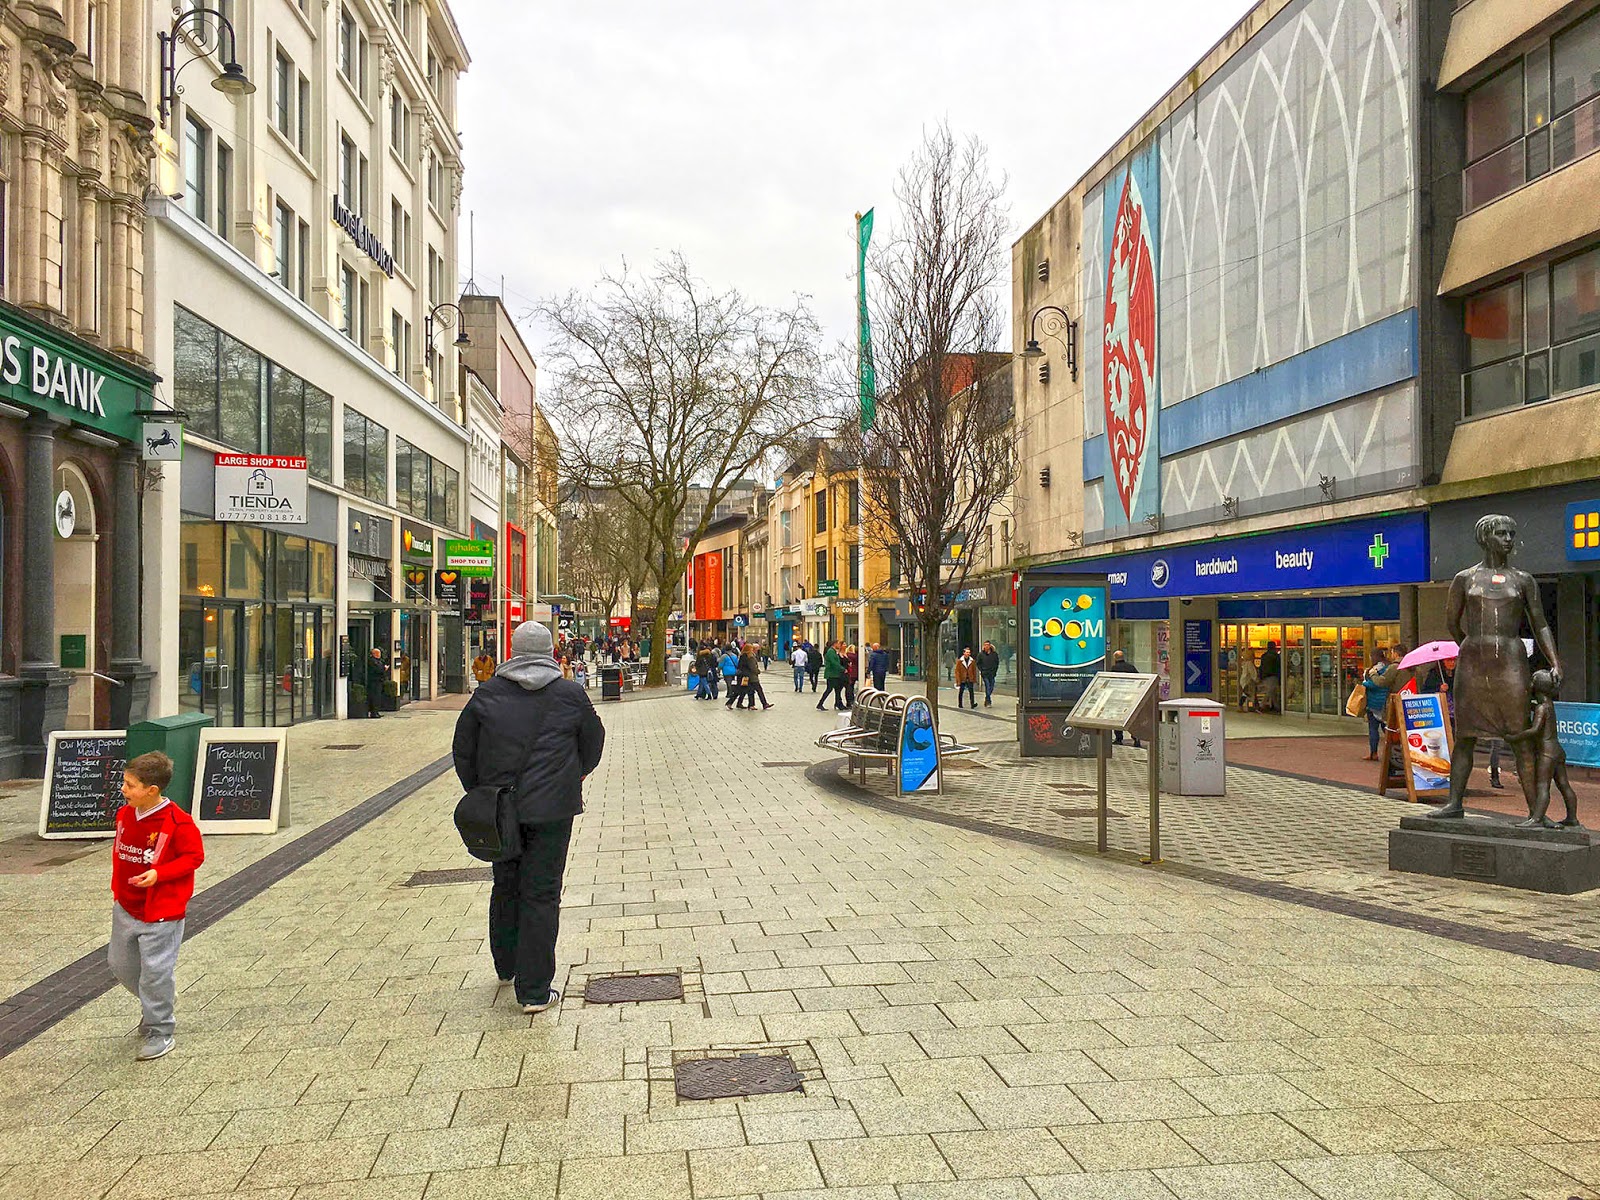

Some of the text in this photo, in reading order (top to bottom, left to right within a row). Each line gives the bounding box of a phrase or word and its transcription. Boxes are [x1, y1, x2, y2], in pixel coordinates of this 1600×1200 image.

[32, 346, 106, 418] BANK
[218, 456, 306, 468] LARGE SHOP TO LET
[229, 495, 292, 509] TIENDA
[1196, 556, 1238, 577] harddwch
[1275, 548, 1314, 571] beauty
[1030, 616, 1103, 640] BOOM
[60, 740, 74, 750] Our
[77, 740, 95, 749] Most
[78, 749, 101, 757] Meals
[212, 746, 266, 760] Traditional
[223, 759, 242, 772] full
[211, 770, 253, 787] English
[206, 784, 262, 798] Breakfast
